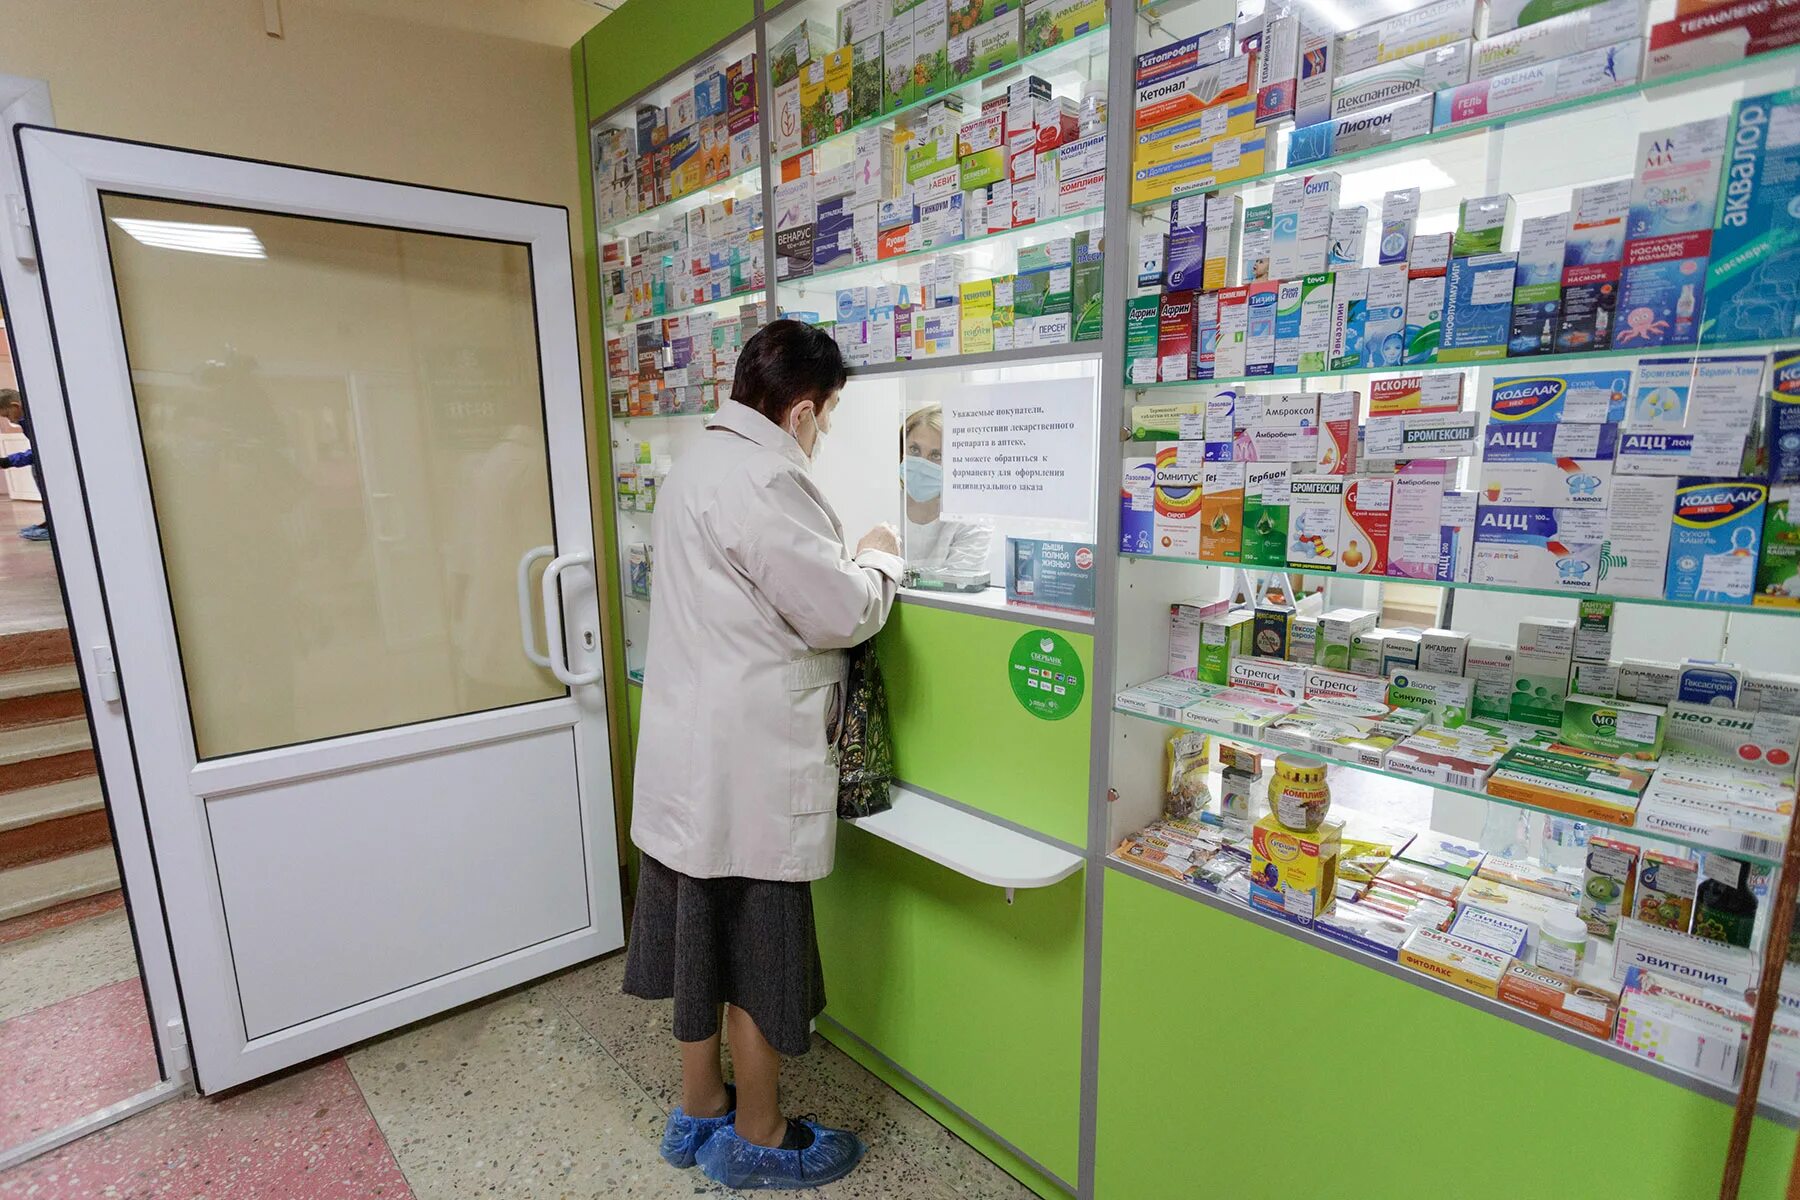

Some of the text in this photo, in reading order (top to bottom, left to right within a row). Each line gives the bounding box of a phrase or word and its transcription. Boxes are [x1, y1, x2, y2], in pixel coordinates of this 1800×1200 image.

[1141, 42, 1197, 68] КЕТОПРОФЕН
[1492, 67, 1544, 89] ОФЕНАК
[1140, 79, 1186, 102] Кетонал
[1336, 78, 1420, 111] Декспантенол
[1457, 96, 1482, 108] ГЕЛЬ
[1336, 113, 1392, 136] Лиотон
[1060, 136, 1105, 156] КОМПЛИВИ
[1724, 105, 1767, 227] аквалор
[932, 174, 956, 189] АЕВИТ
[1060, 175, 1104, 193] КОМПЛИВИ
[1305, 180, 1329, 195] СНУП
[777, 227, 811, 245] ВЕНАРУС
[1307, 276, 1326, 284] teva
[1567, 273, 1607, 283] НАСМОРК
[1251, 294, 1276, 306] Тизин
[1129, 307, 1157, 321] Африн
[1161, 303, 1191, 318] Африн
[1039, 324, 1066, 334] ПЕРСЕН
[1640, 369, 1690, 379] Бромгексин
[1374, 378, 1422, 392] АСКОРИЛ
[1495, 383, 1559, 401] КОДЕЛАК
[952, 409, 995, 418] Уважаемые
[1265, 408, 1314, 417] Амброксол
[952, 422, 1075, 435] при отсутствии лекарственного
[1407, 429, 1470, 442] БРОМГЕКСИН
[1489, 431, 1538, 449] АЦЦ
[952, 440, 989, 448] препарата
[1626, 436, 1692, 450] АЦЦ лон
[994, 454, 1038, 464] обратиться
[997, 469, 1011, 477] для
[1015, 468, 1065, 478] оформления
[1156, 471, 1199, 484] Омнитус
[1249, 470, 1286, 484] Гербион
[952, 483, 1017, 492] индивидуального
[1292, 483, 1340, 493] БРОМГЕКСИН
[1396, 478, 1440, 487] Амбробене
[1680, 490, 1759, 506] КОДЕЛАК
[1481, 513, 1528, 530] АЦЦ
[1041, 543, 1063, 551] ДЫШИ
[1041, 551, 1070, 560] ПОЛНОЙ
[1041, 559, 1071, 568] ЖИЗНЬЮ
[1438, 556, 1451, 578] АЦЦ
[1292, 623, 1315, 632] Гексор
[1386, 643, 1413, 652] Каметон
[1425, 644, 1457, 653] ИНГАЛИПТ
[1467, 658, 1510, 668] МИРАМИСТИН
[1234, 665, 1280, 681] Стрепси
[1309, 675, 1358, 693] Стрепси
[1684, 679, 1733, 692] Гексаспрей
[1672, 711, 1713, 724] нео
[1646, 814, 1711, 836] Стрепсилс
[1419, 930, 1504, 962] ФИТОЛАКС
[1406, 956, 1453, 978] ФИТОЛАКС
